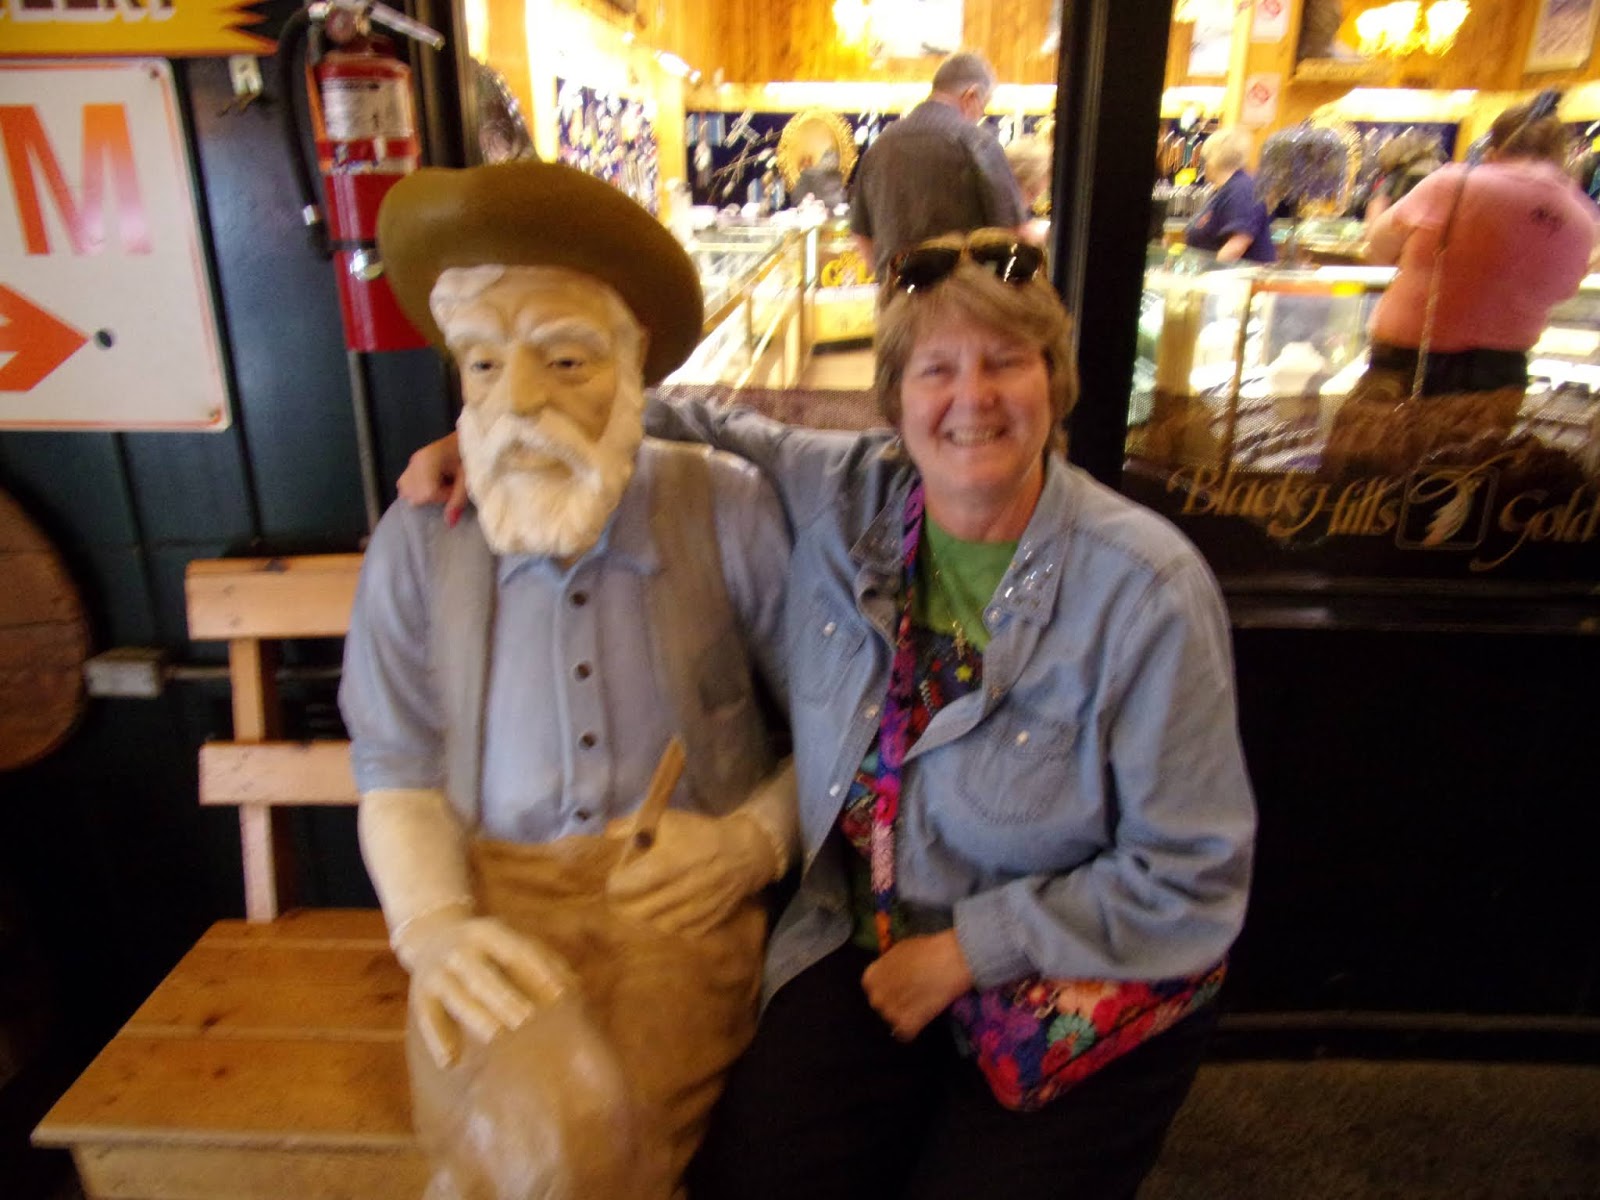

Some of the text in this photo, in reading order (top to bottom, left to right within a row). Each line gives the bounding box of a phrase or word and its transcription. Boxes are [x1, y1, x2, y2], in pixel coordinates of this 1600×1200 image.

[1166, 465, 1600, 572] Black Hills Gold
